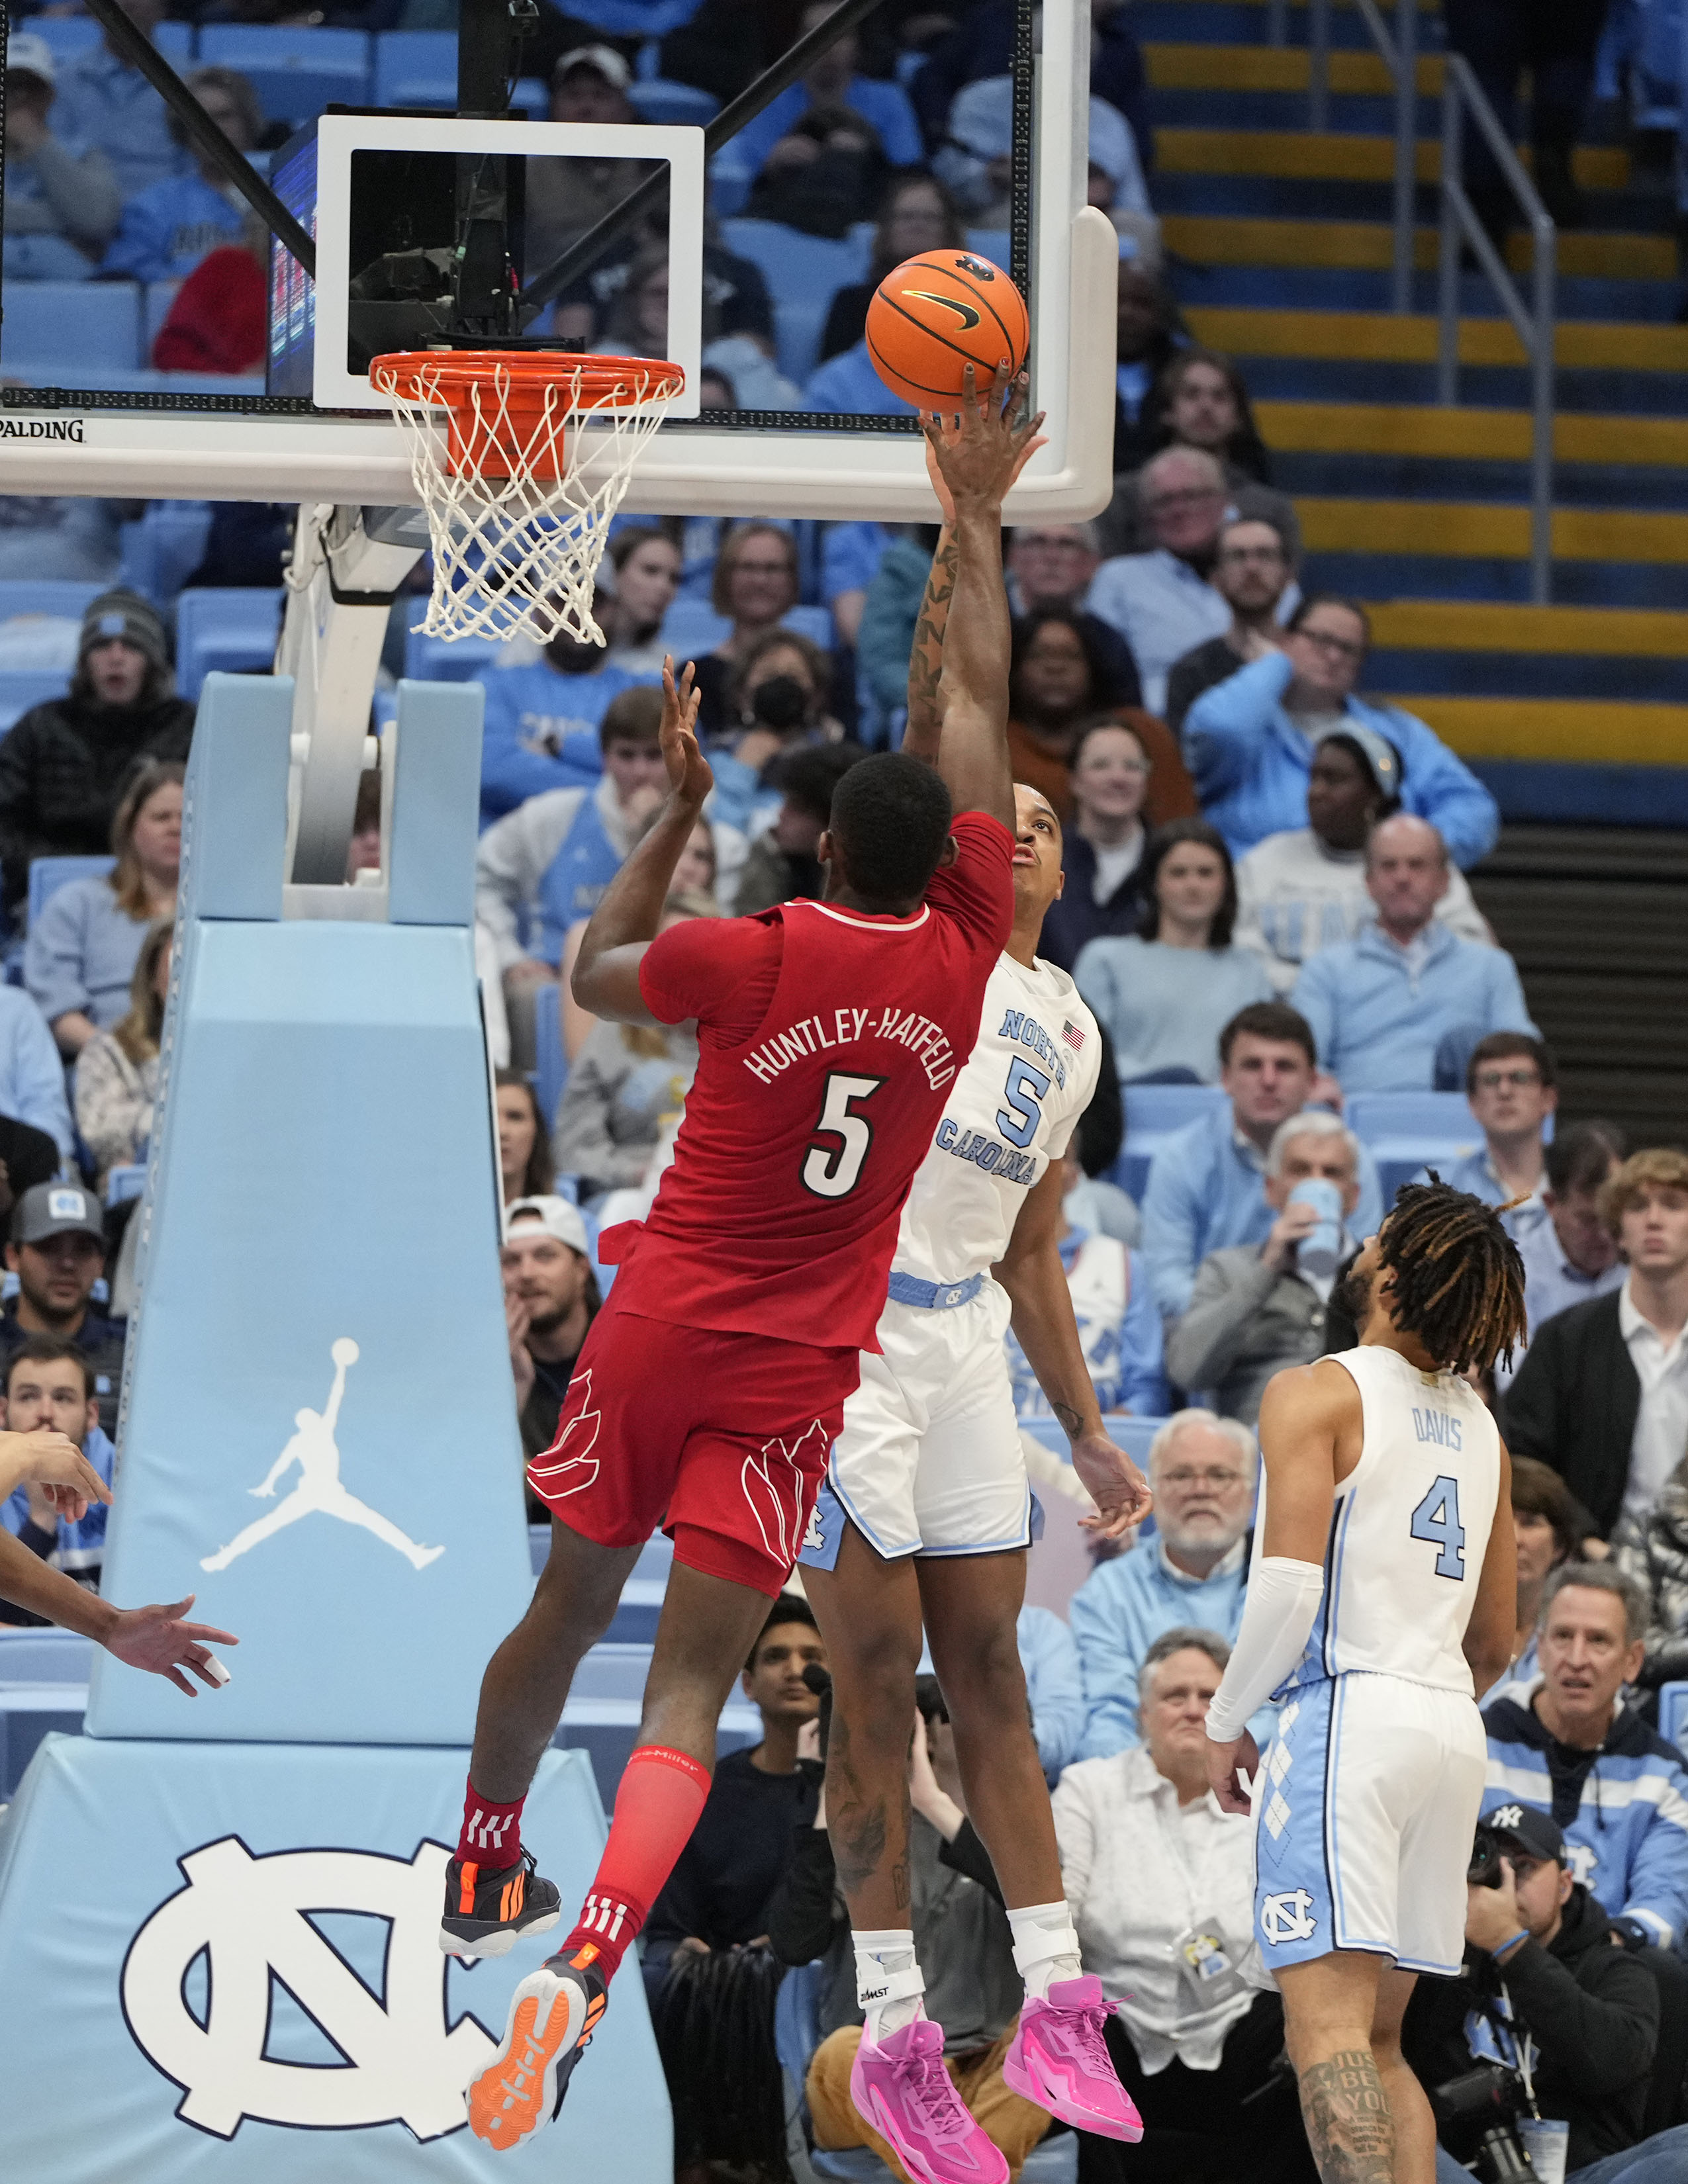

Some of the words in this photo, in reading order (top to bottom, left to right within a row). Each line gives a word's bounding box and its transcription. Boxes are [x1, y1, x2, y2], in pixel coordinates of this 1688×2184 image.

[998, 1009, 1066, 1091] NORTH
[798, 1069, 890, 1200] 5
[996, 1055, 1051, 1149] 5
[1411, 1408, 1462, 1451] DAVIS
[1410, 1475, 1465, 1581] 4
[1340, 2070, 1375, 2089] BE
